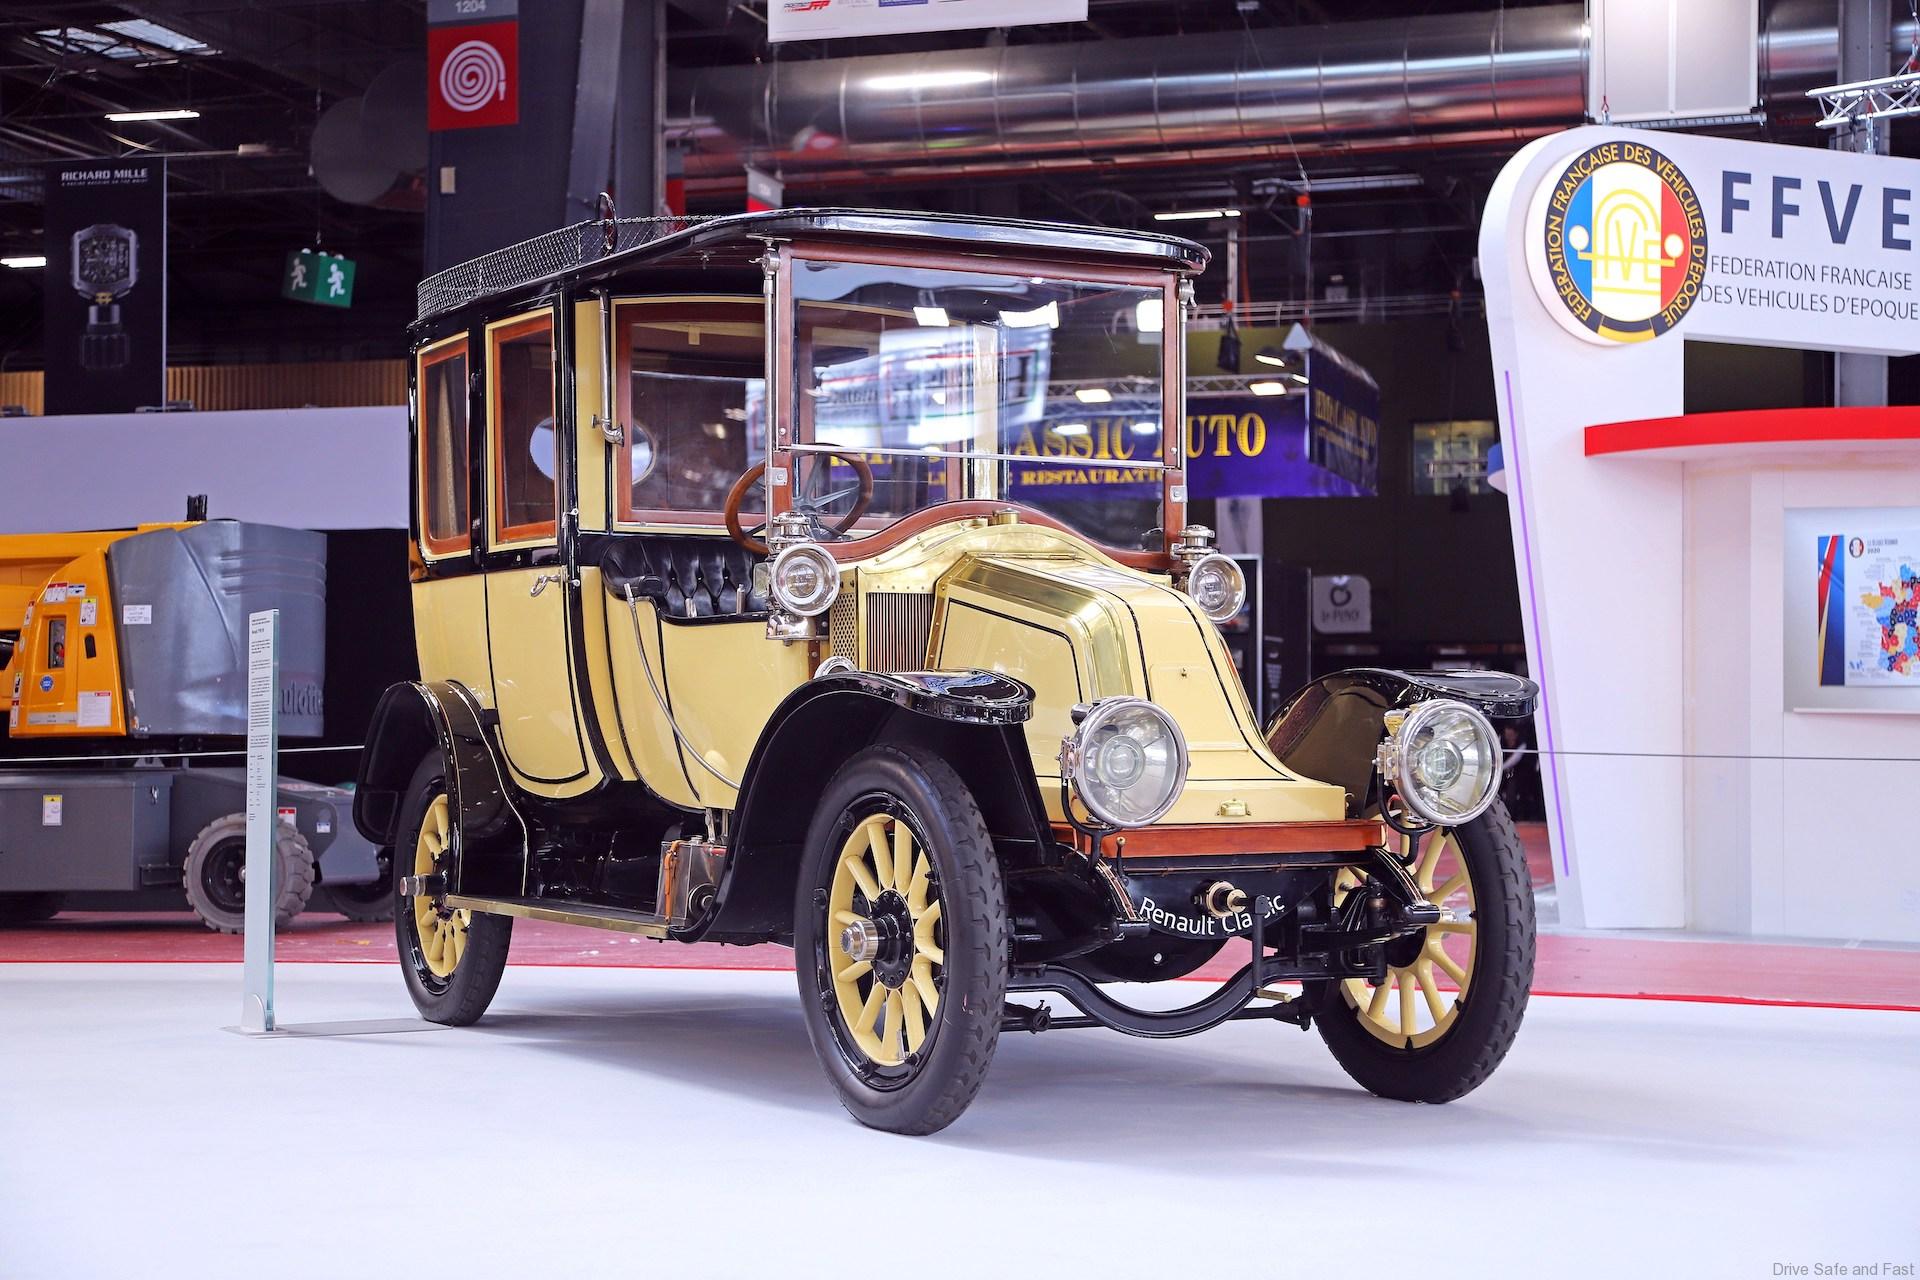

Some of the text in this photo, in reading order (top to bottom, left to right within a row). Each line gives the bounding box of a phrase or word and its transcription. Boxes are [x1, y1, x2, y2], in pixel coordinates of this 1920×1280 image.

[455, 0, 487, 13] 1204
[61, 167, 148, 181] RICHARD MILLE
[1552, 144, 1620, 212] FRANÇAISE
[1624, 143, 1652, 166] DES
[1656, 155, 1705, 239] VÉHICULES
[1721, 170, 1912, 251] FFVE
[1711, 255, 1912, 291] FEDERATION FRANCAISE
[1700, 284, 1919, 321] DES VEHICULES D'EPOQUE
[1139, 894, 1286, 936] Renault Claic
